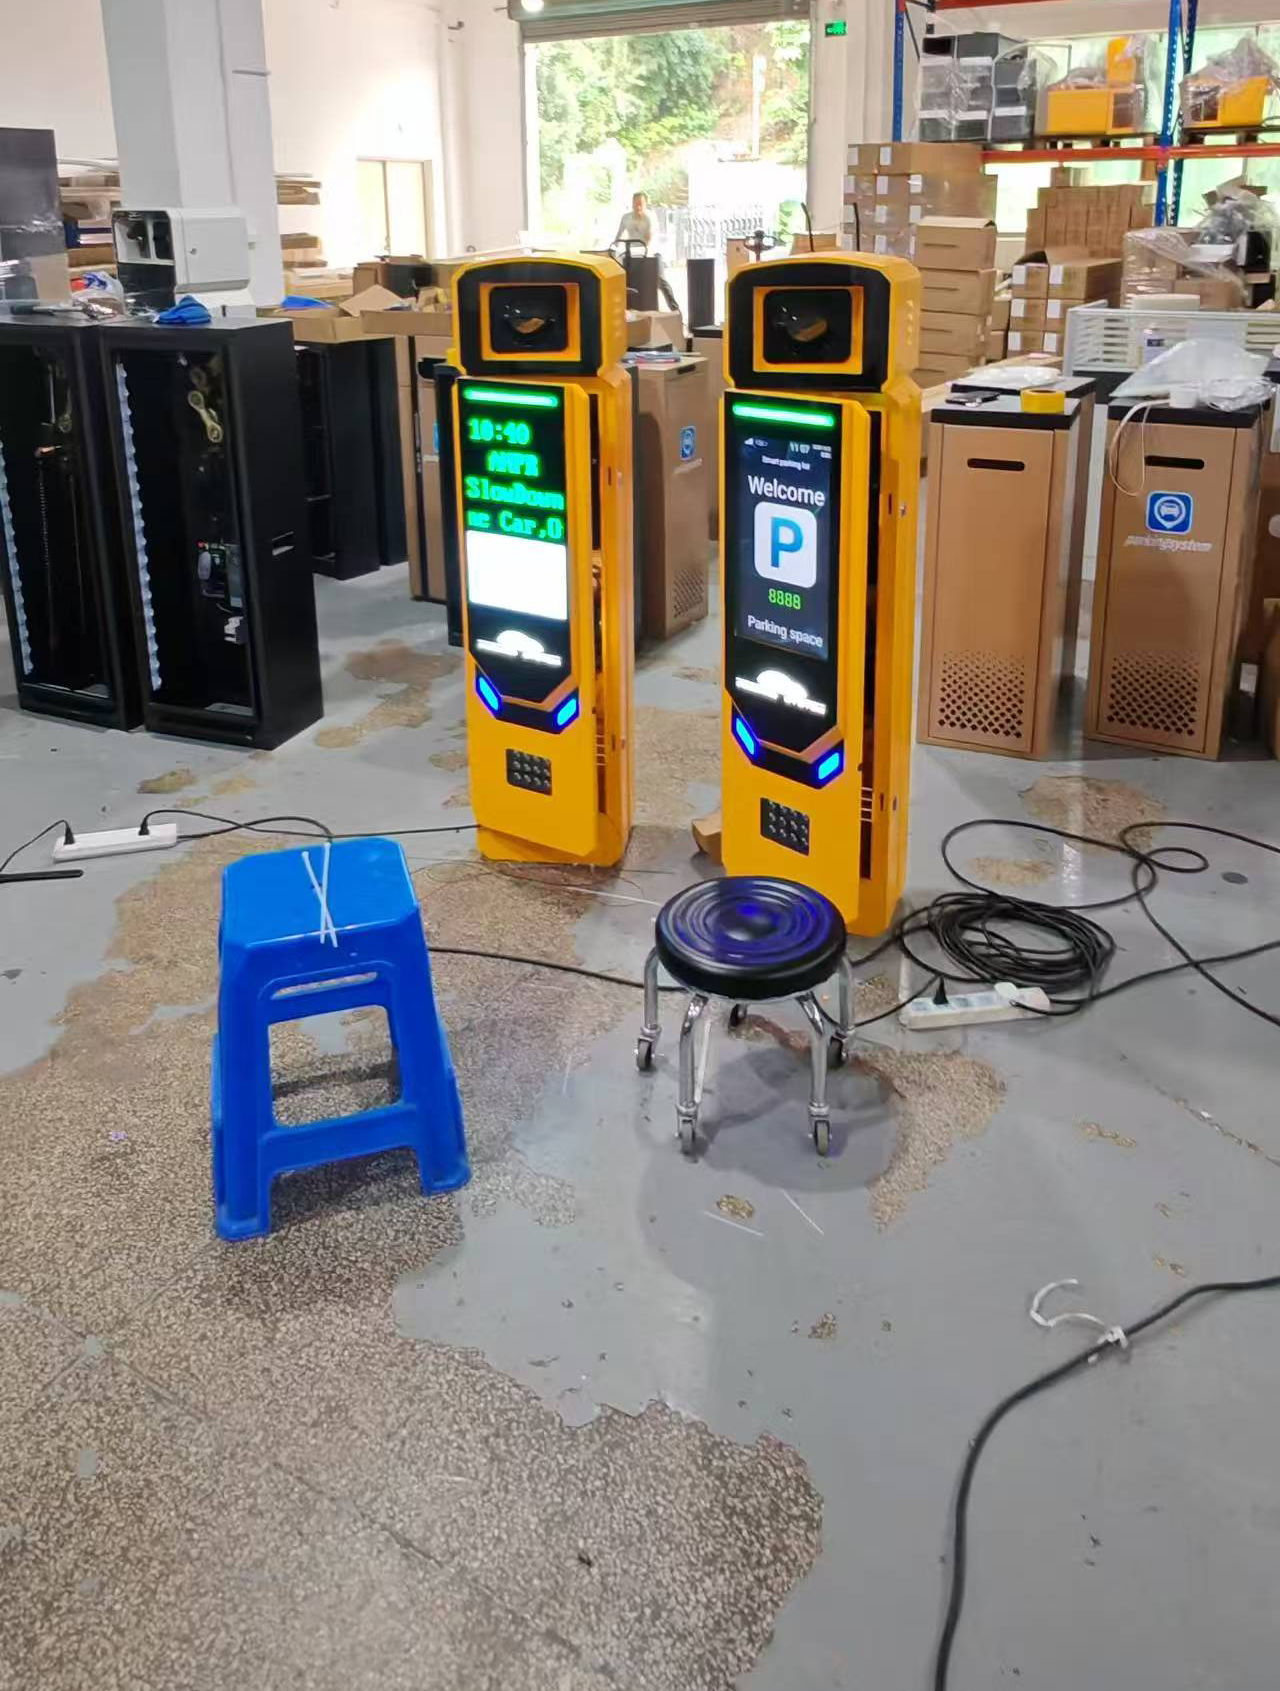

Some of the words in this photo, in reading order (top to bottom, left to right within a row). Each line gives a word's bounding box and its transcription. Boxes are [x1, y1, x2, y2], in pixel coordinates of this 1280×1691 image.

[469, 418, 531, 445] 10:40
[748, 475, 825, 506] Welcome
[770, 516, 803, 568] P
[768, 588, 801, 610] 8888
[748, 615, 788, 640] Parking
[789, 629, 823, 648] space
